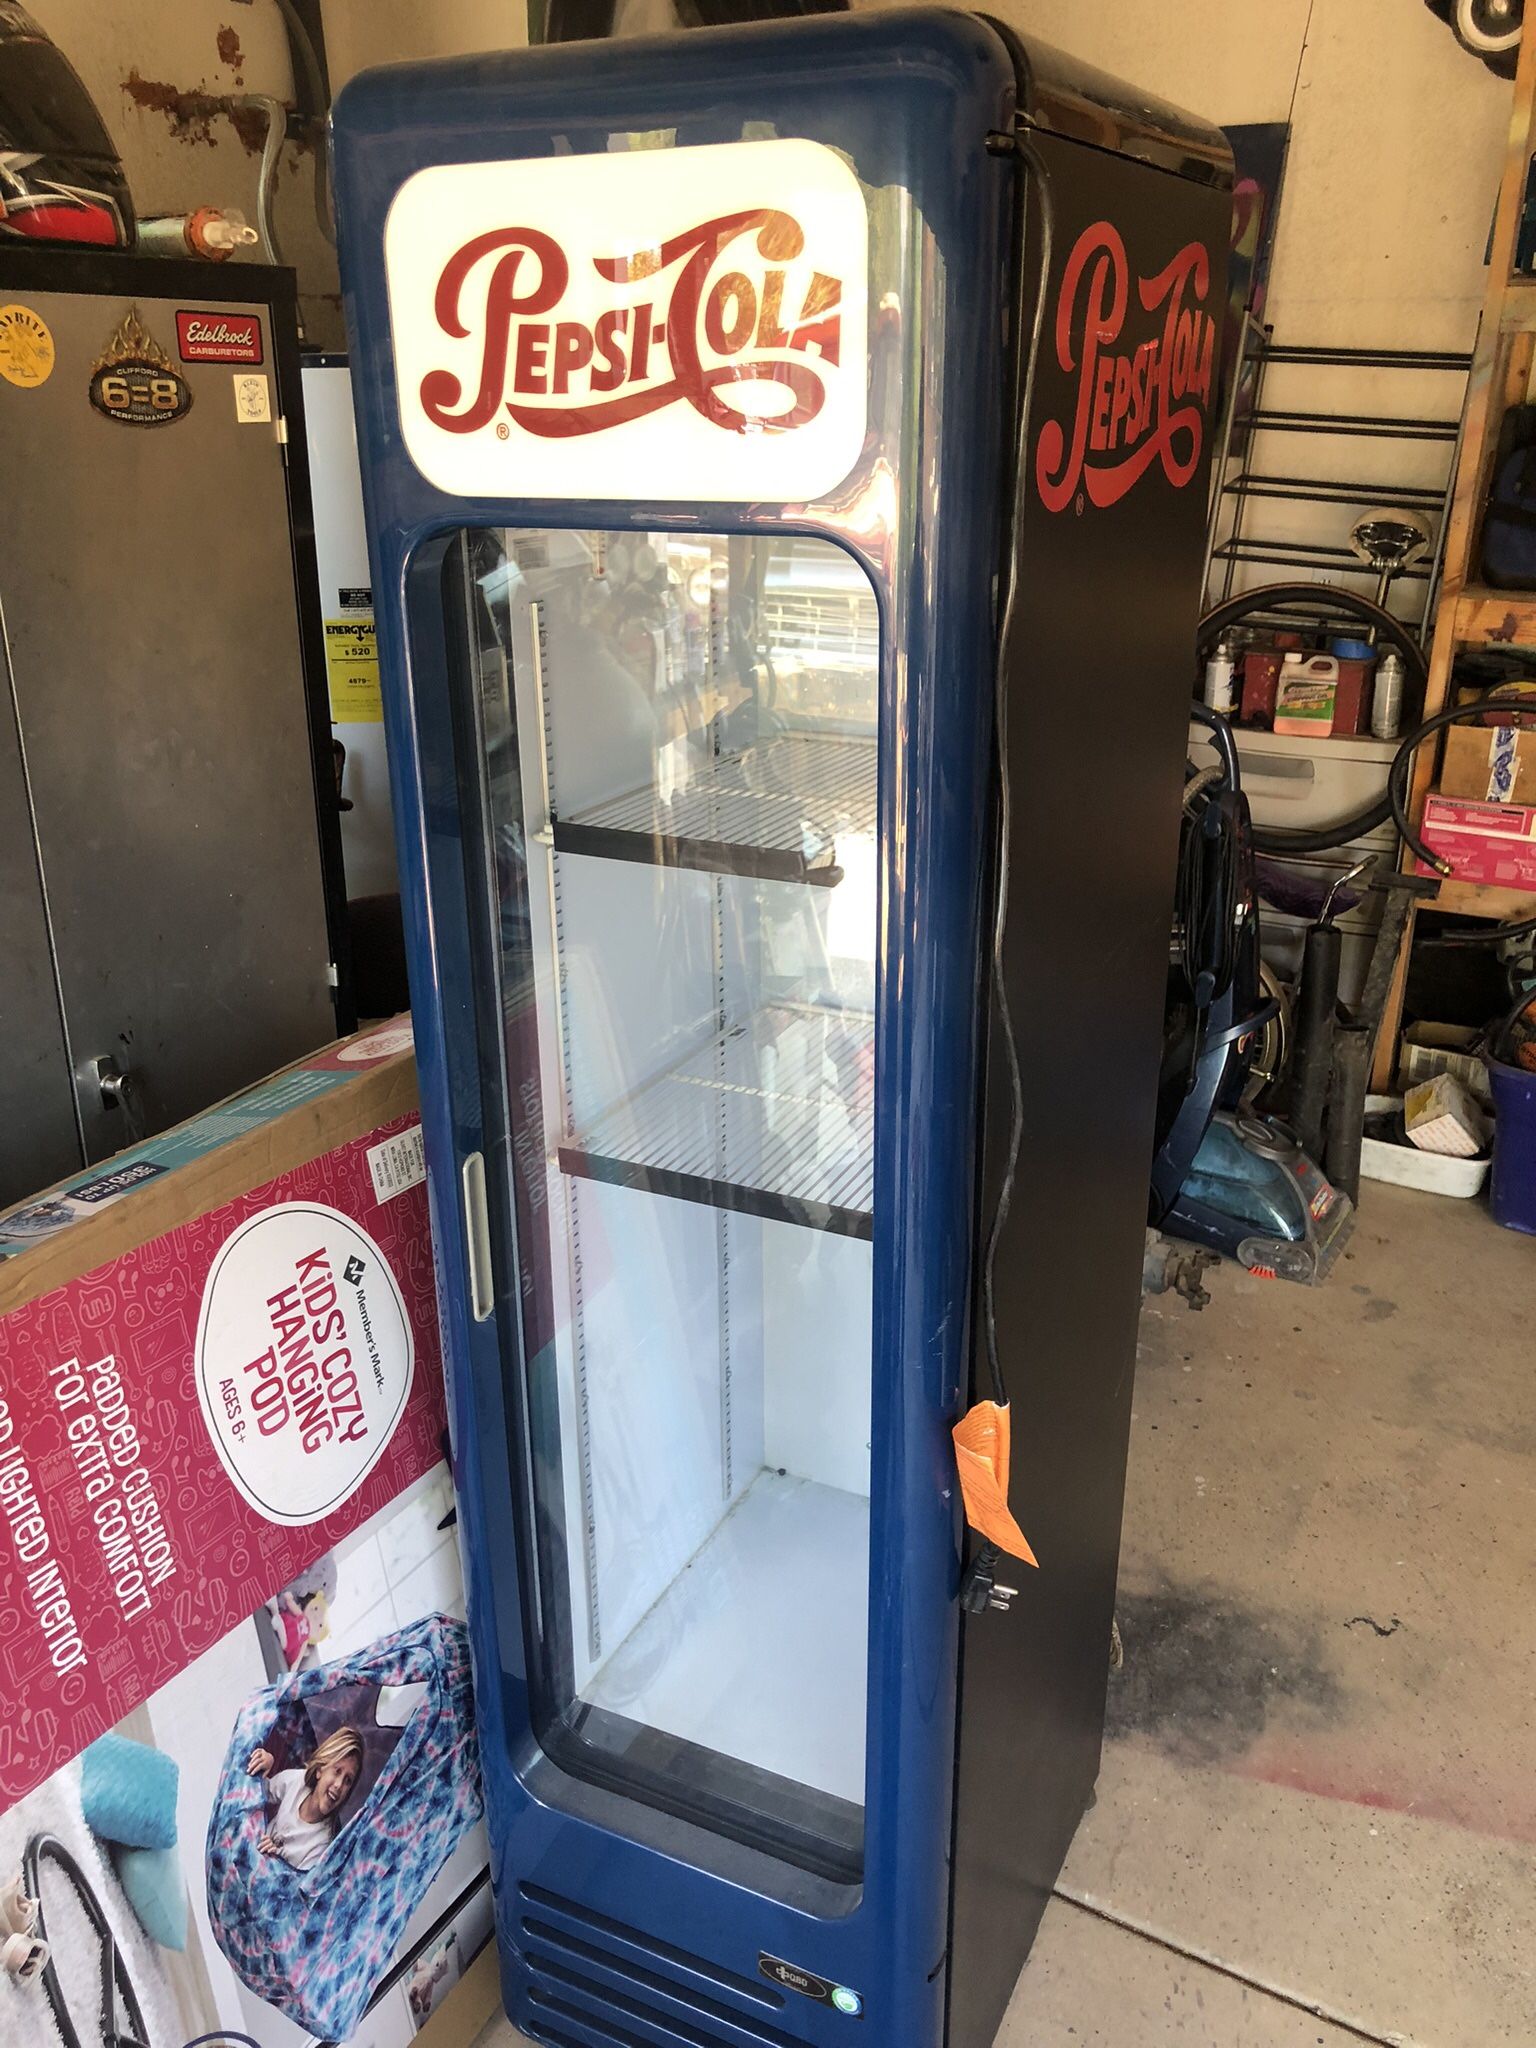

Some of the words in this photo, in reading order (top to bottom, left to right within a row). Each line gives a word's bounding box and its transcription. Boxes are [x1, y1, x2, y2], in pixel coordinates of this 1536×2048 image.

[187, 321, 253, 346] Edelbrock
[189, 347, 254, 357] CARBURETORS
[420, 208, 842, 438] PEPSI-COLA
[117, 367, 159, 377] CLIFFORD
[111, 409, 173, 422] PERFORMANCE
[351, 647, 370, 656] 520
[356, 1289, 377, 1353] Member's
[370, 1354, 384, 1387] Mark
[218, 1377, 242, 1421] AGES
[230, 1422, 247, 1443] 6+
[243, 1345, 291, 1437] POD
[321, 1346, 369, 1444] COZY
[121, 1467, 177, 1589] CUSHION
